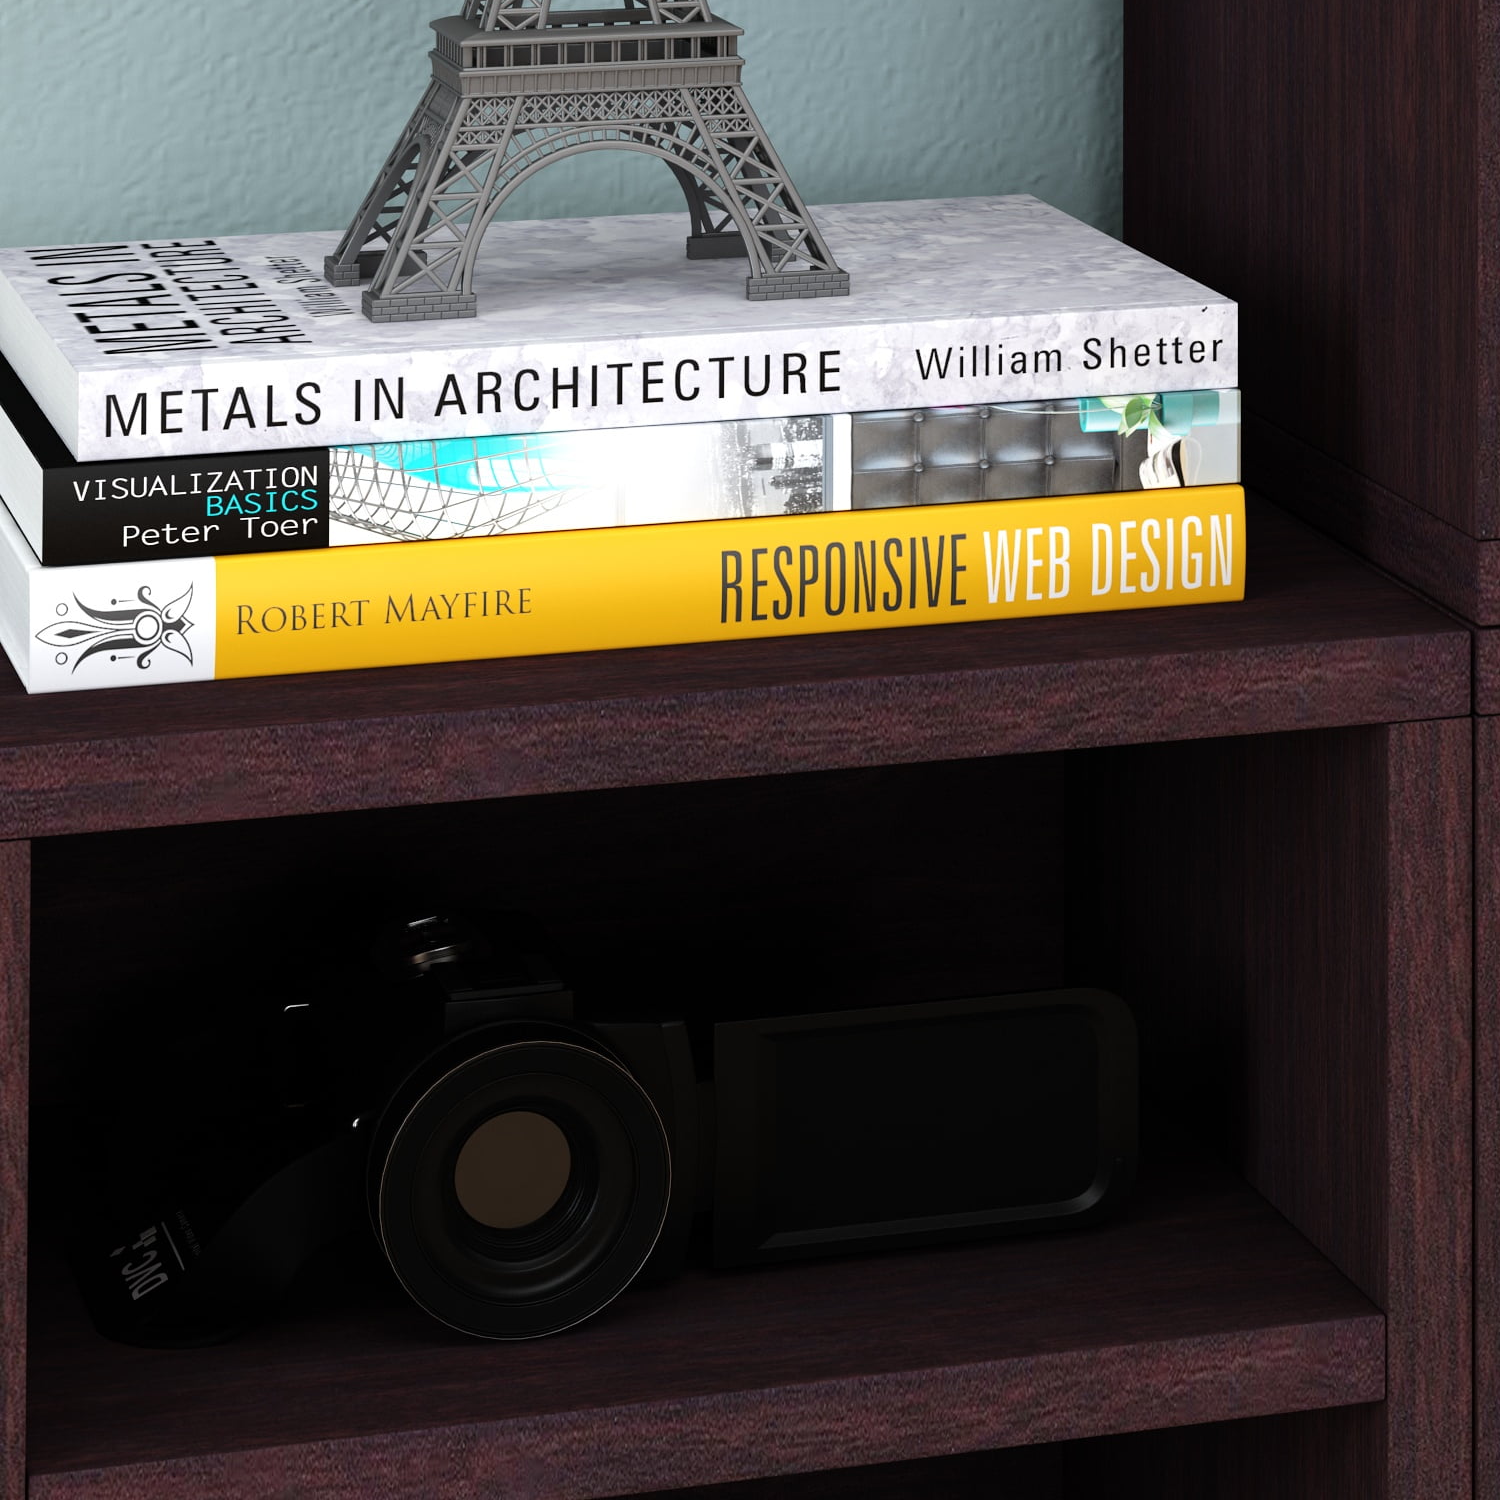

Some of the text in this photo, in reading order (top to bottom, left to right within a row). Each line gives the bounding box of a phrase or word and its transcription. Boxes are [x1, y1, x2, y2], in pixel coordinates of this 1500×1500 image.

[25, 245, 218, 355] METALS IN
[140, 240, 312, 344] ARCHITECTURE
[265, 255, 354, 318] William Shetter
[915, 334, 1224, 382] William Shetter
[104, 350, 842, 438] METALS IN ARCHITECTURE
[73, 465, 318, 501] VISUALIZATION
[206, 489, 318, 517] BASICS
[122, 515, 318, 547] Peter Toer
[720, 512, 1235, 624] RESPONSIVE WEB DESIGN
[237, 587, 534, 635] ROBERT MAYFIRE
